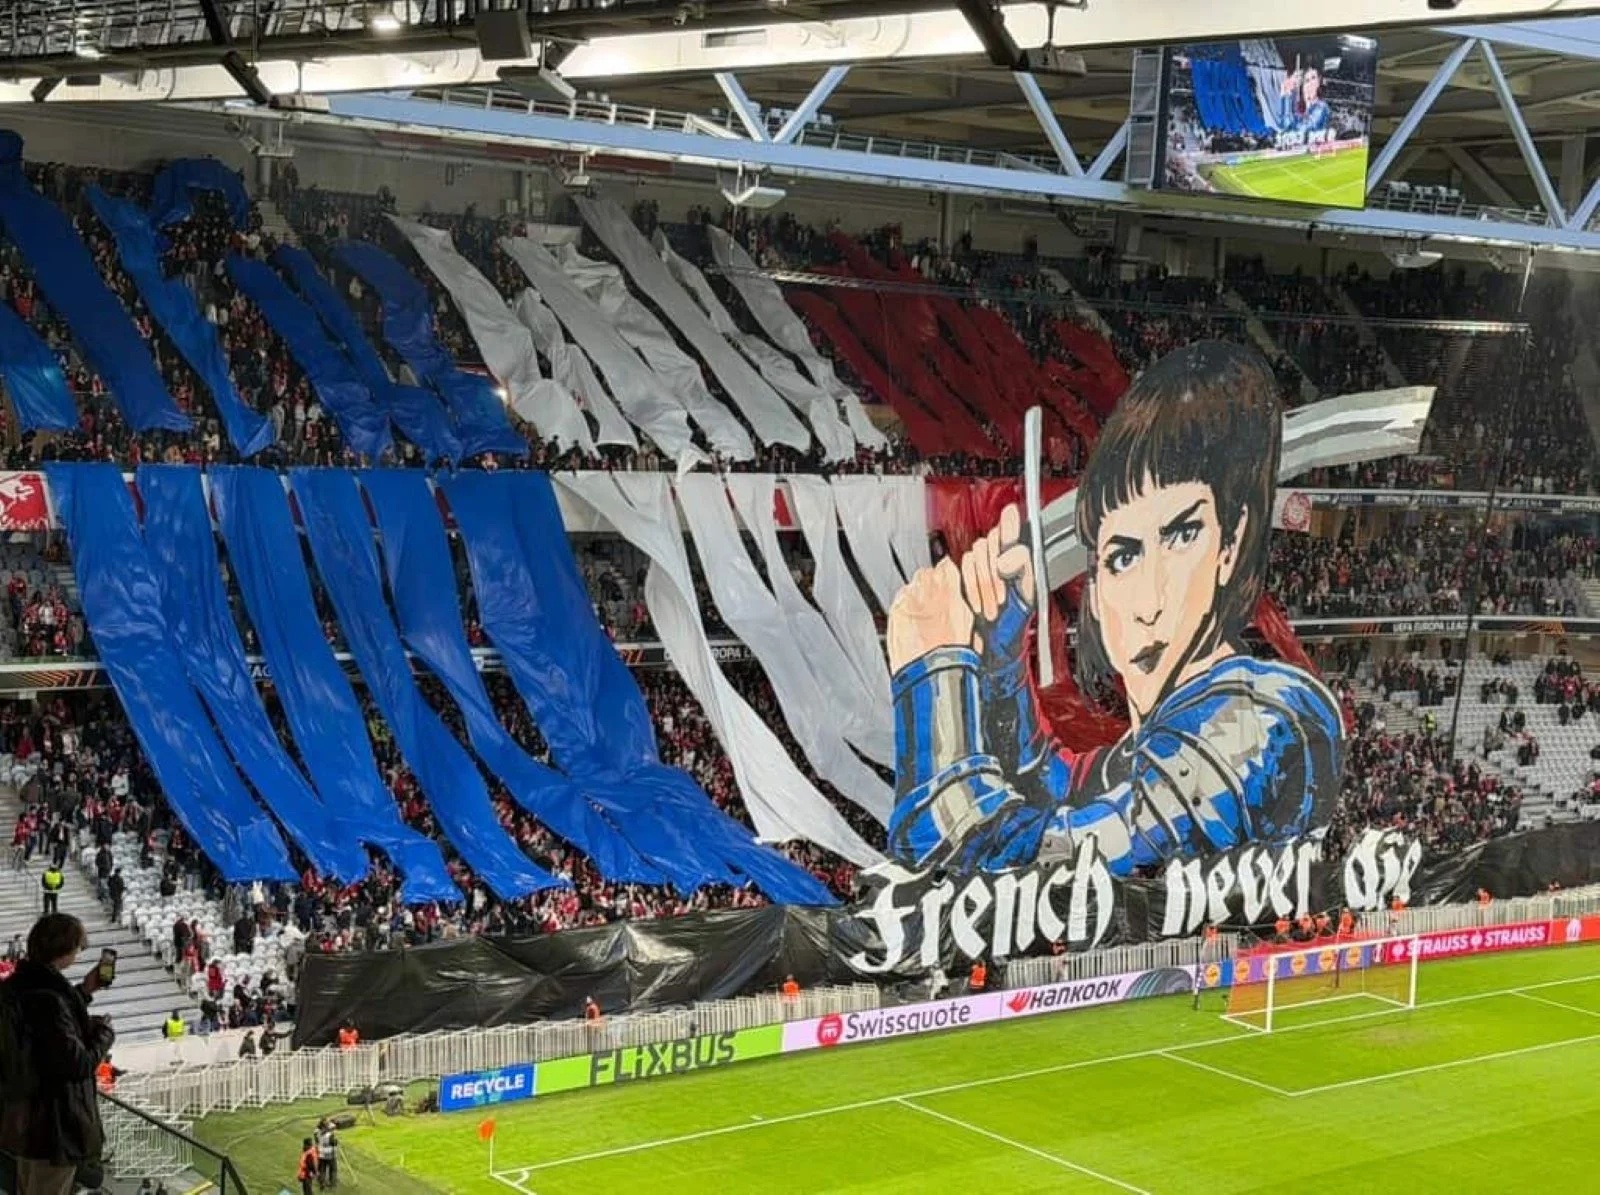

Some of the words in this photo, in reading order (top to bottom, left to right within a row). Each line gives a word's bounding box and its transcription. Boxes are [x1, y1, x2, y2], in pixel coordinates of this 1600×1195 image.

[850, 832, 1114, 973] French
[1161, 825, 1331, 936] never
[1407, 935, 1468, 956] STRAUSS
[1485, 926, 1545, 947] STRAUSS
[845, 1002, 971, 1040] Swissquote
[451, 1073, 525, 1099] RECYCLE
